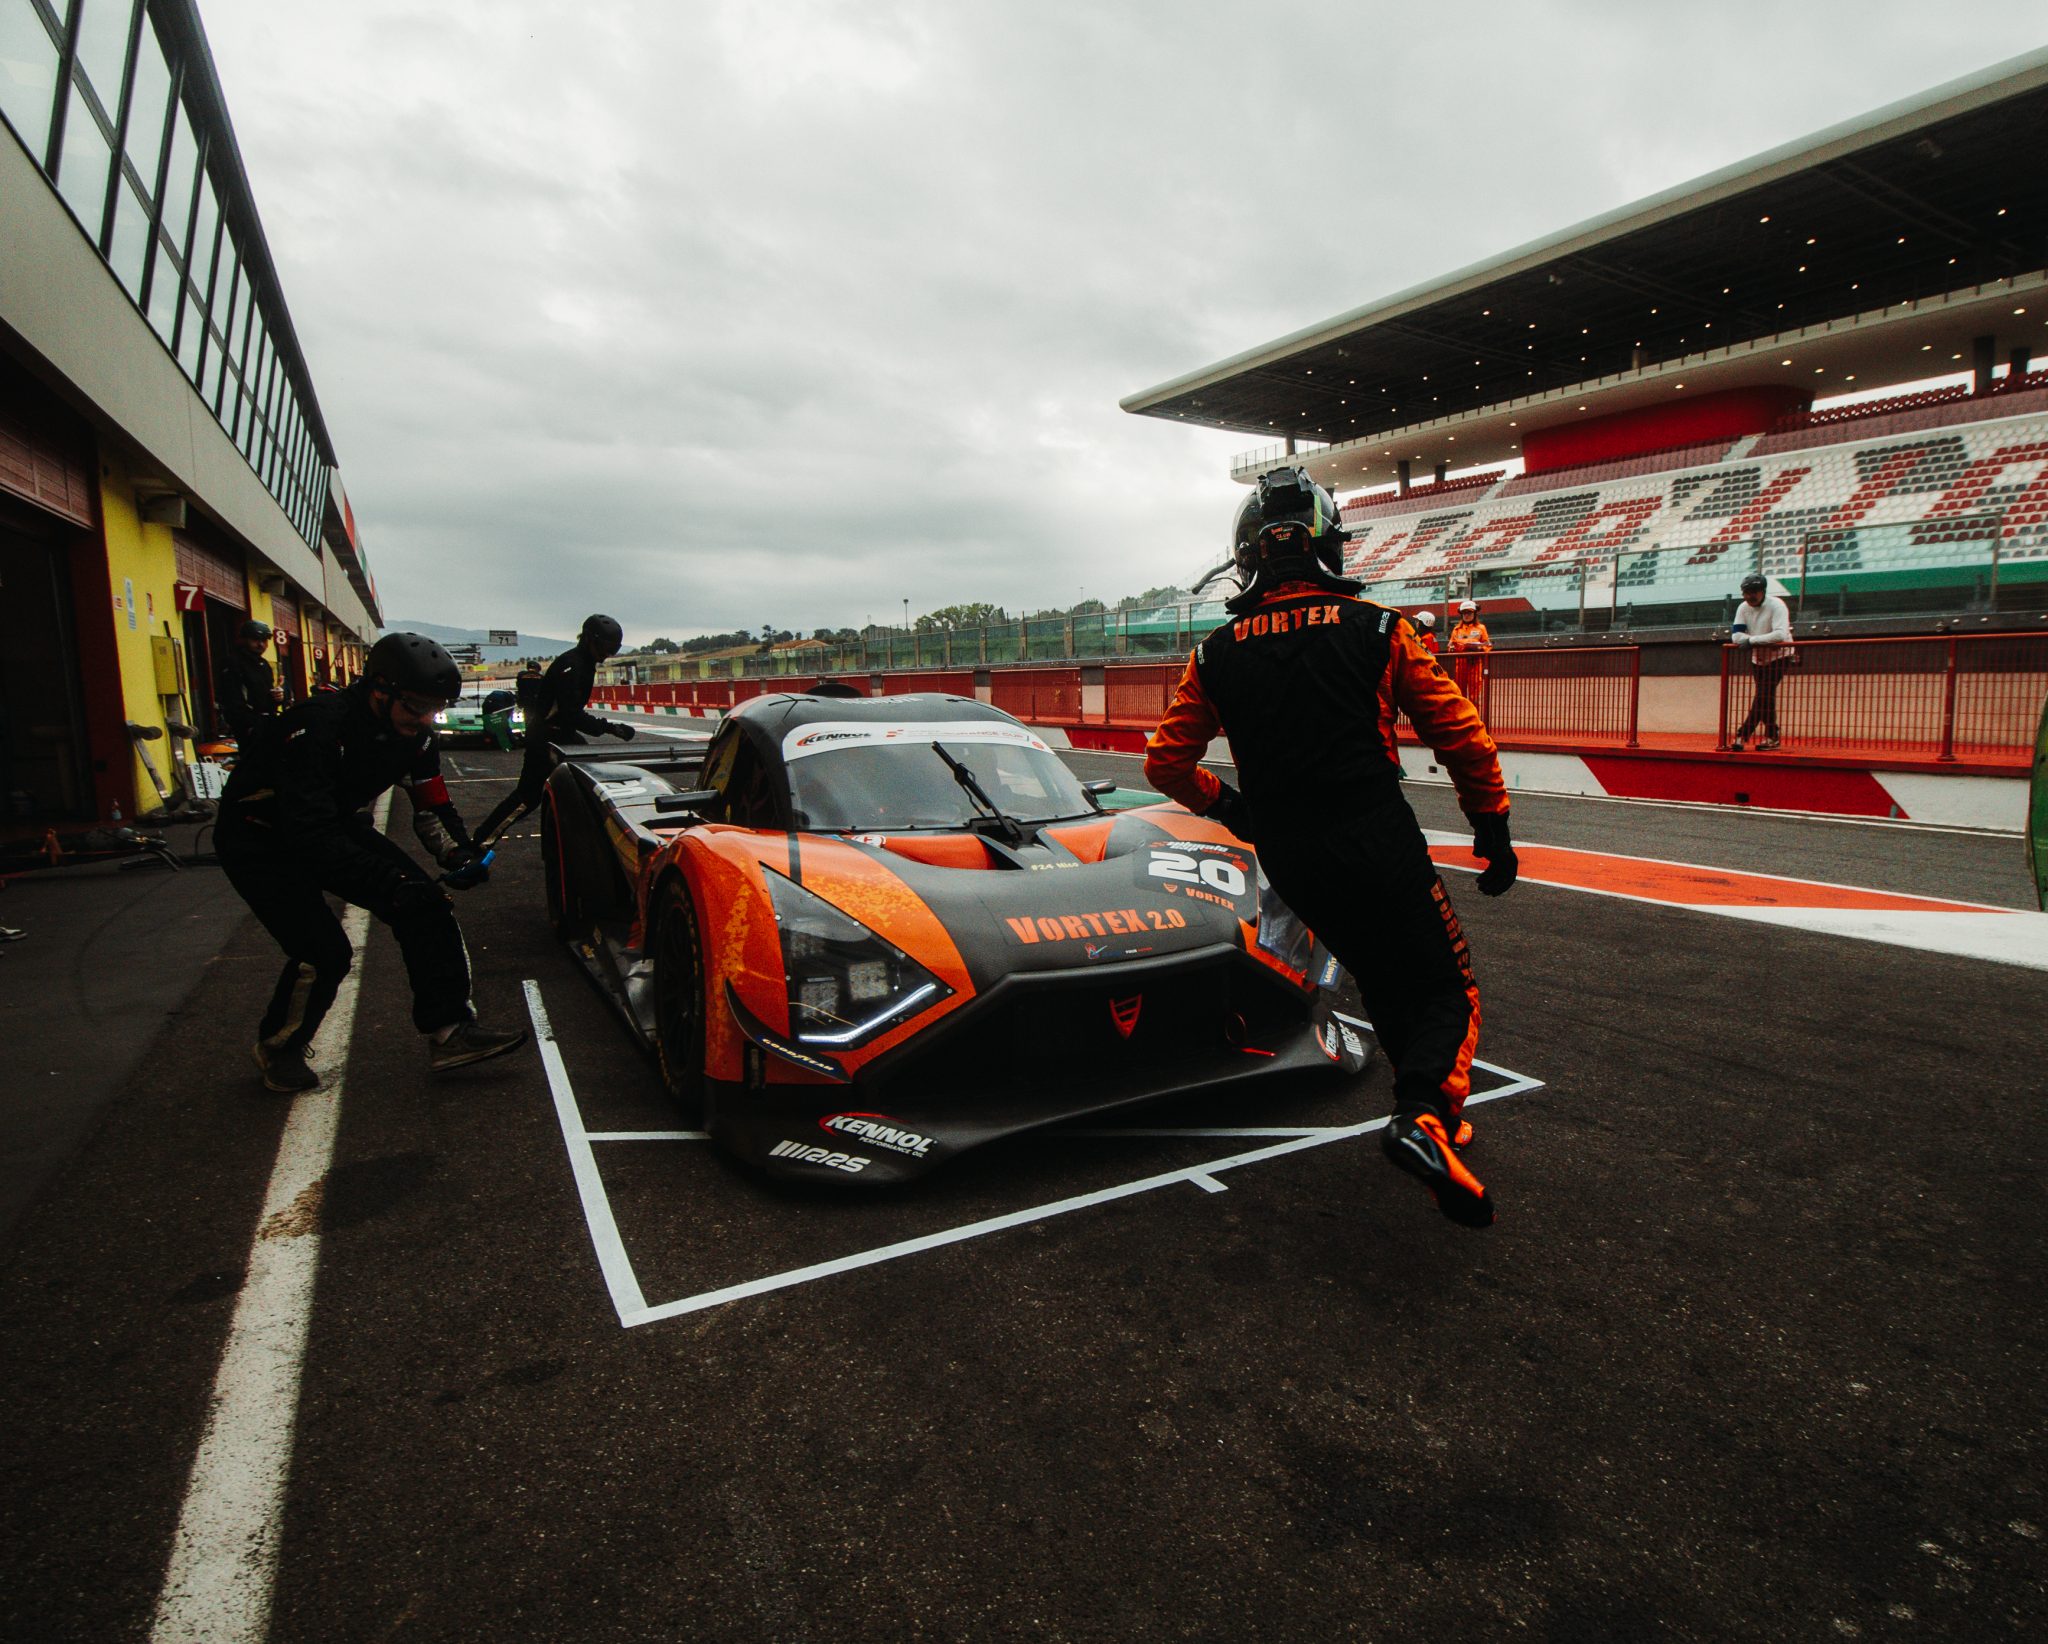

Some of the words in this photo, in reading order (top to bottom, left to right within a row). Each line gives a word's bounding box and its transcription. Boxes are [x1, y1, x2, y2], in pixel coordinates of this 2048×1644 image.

[180, 586, 198, 609] 7
[1234, 605, 1340, 642] VORTEX
[276, 630, 287, 645] 8
[315, 649, 323, 660] 9
[335, 660, 343, 668] 10
[803, 732, 872, 745] KENNOL
[193, 764, 205, 796] START
[1185, 887, 1235, 912] VORTEX
[1004, 909, 1149, 944] VORTEX
[1146, 908, 1187, 930] 2.0
[762, 1038, 834, 1071] GOODYEAR
[825, 1115, 934, 1152] KENNOL
[859, 1136, 912, 1154] PERFORMANCE
[911, 1150, 924, 1158] OIL
